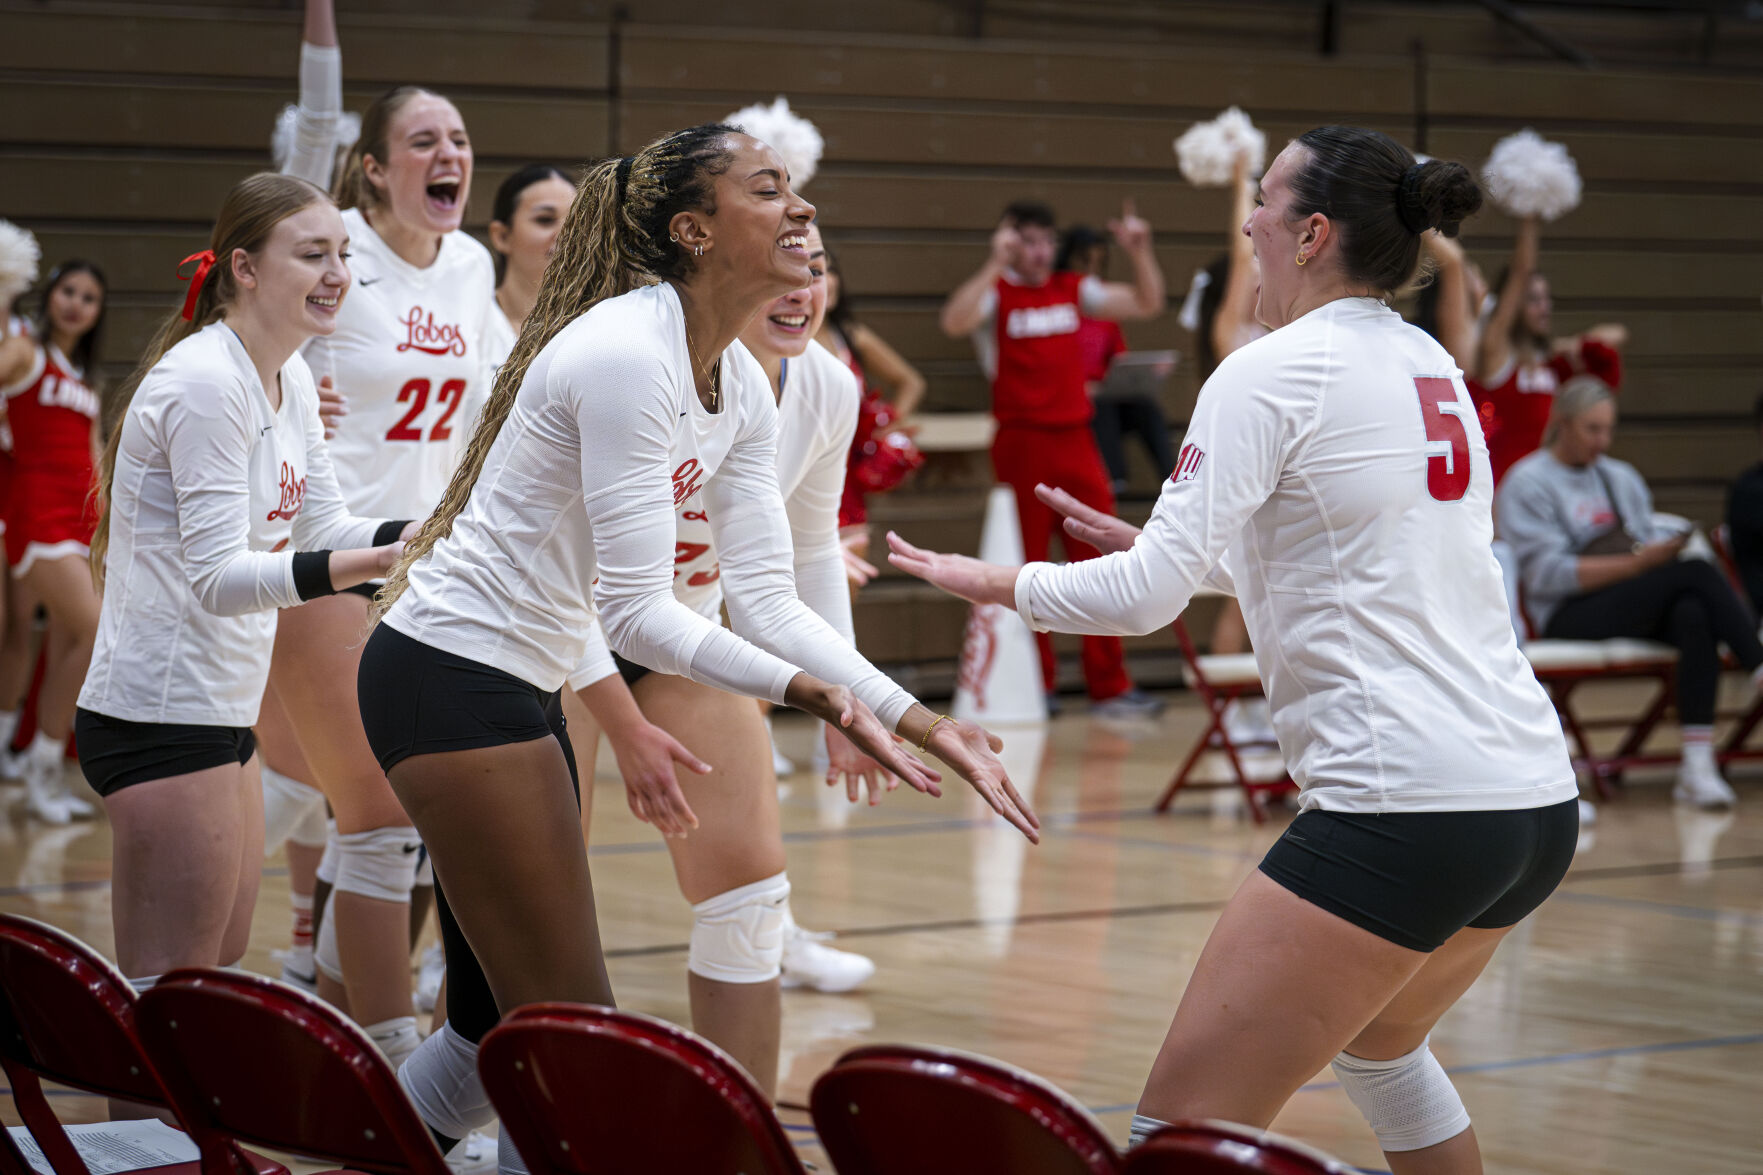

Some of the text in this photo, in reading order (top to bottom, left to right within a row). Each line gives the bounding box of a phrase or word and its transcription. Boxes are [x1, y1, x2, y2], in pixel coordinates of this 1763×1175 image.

[397, 305, 466, 357] Lobos
[385, 377, 467, 442] 22
[1411, 374, 1472, 503] 5
[267, 460, 308, 521] Lobo
